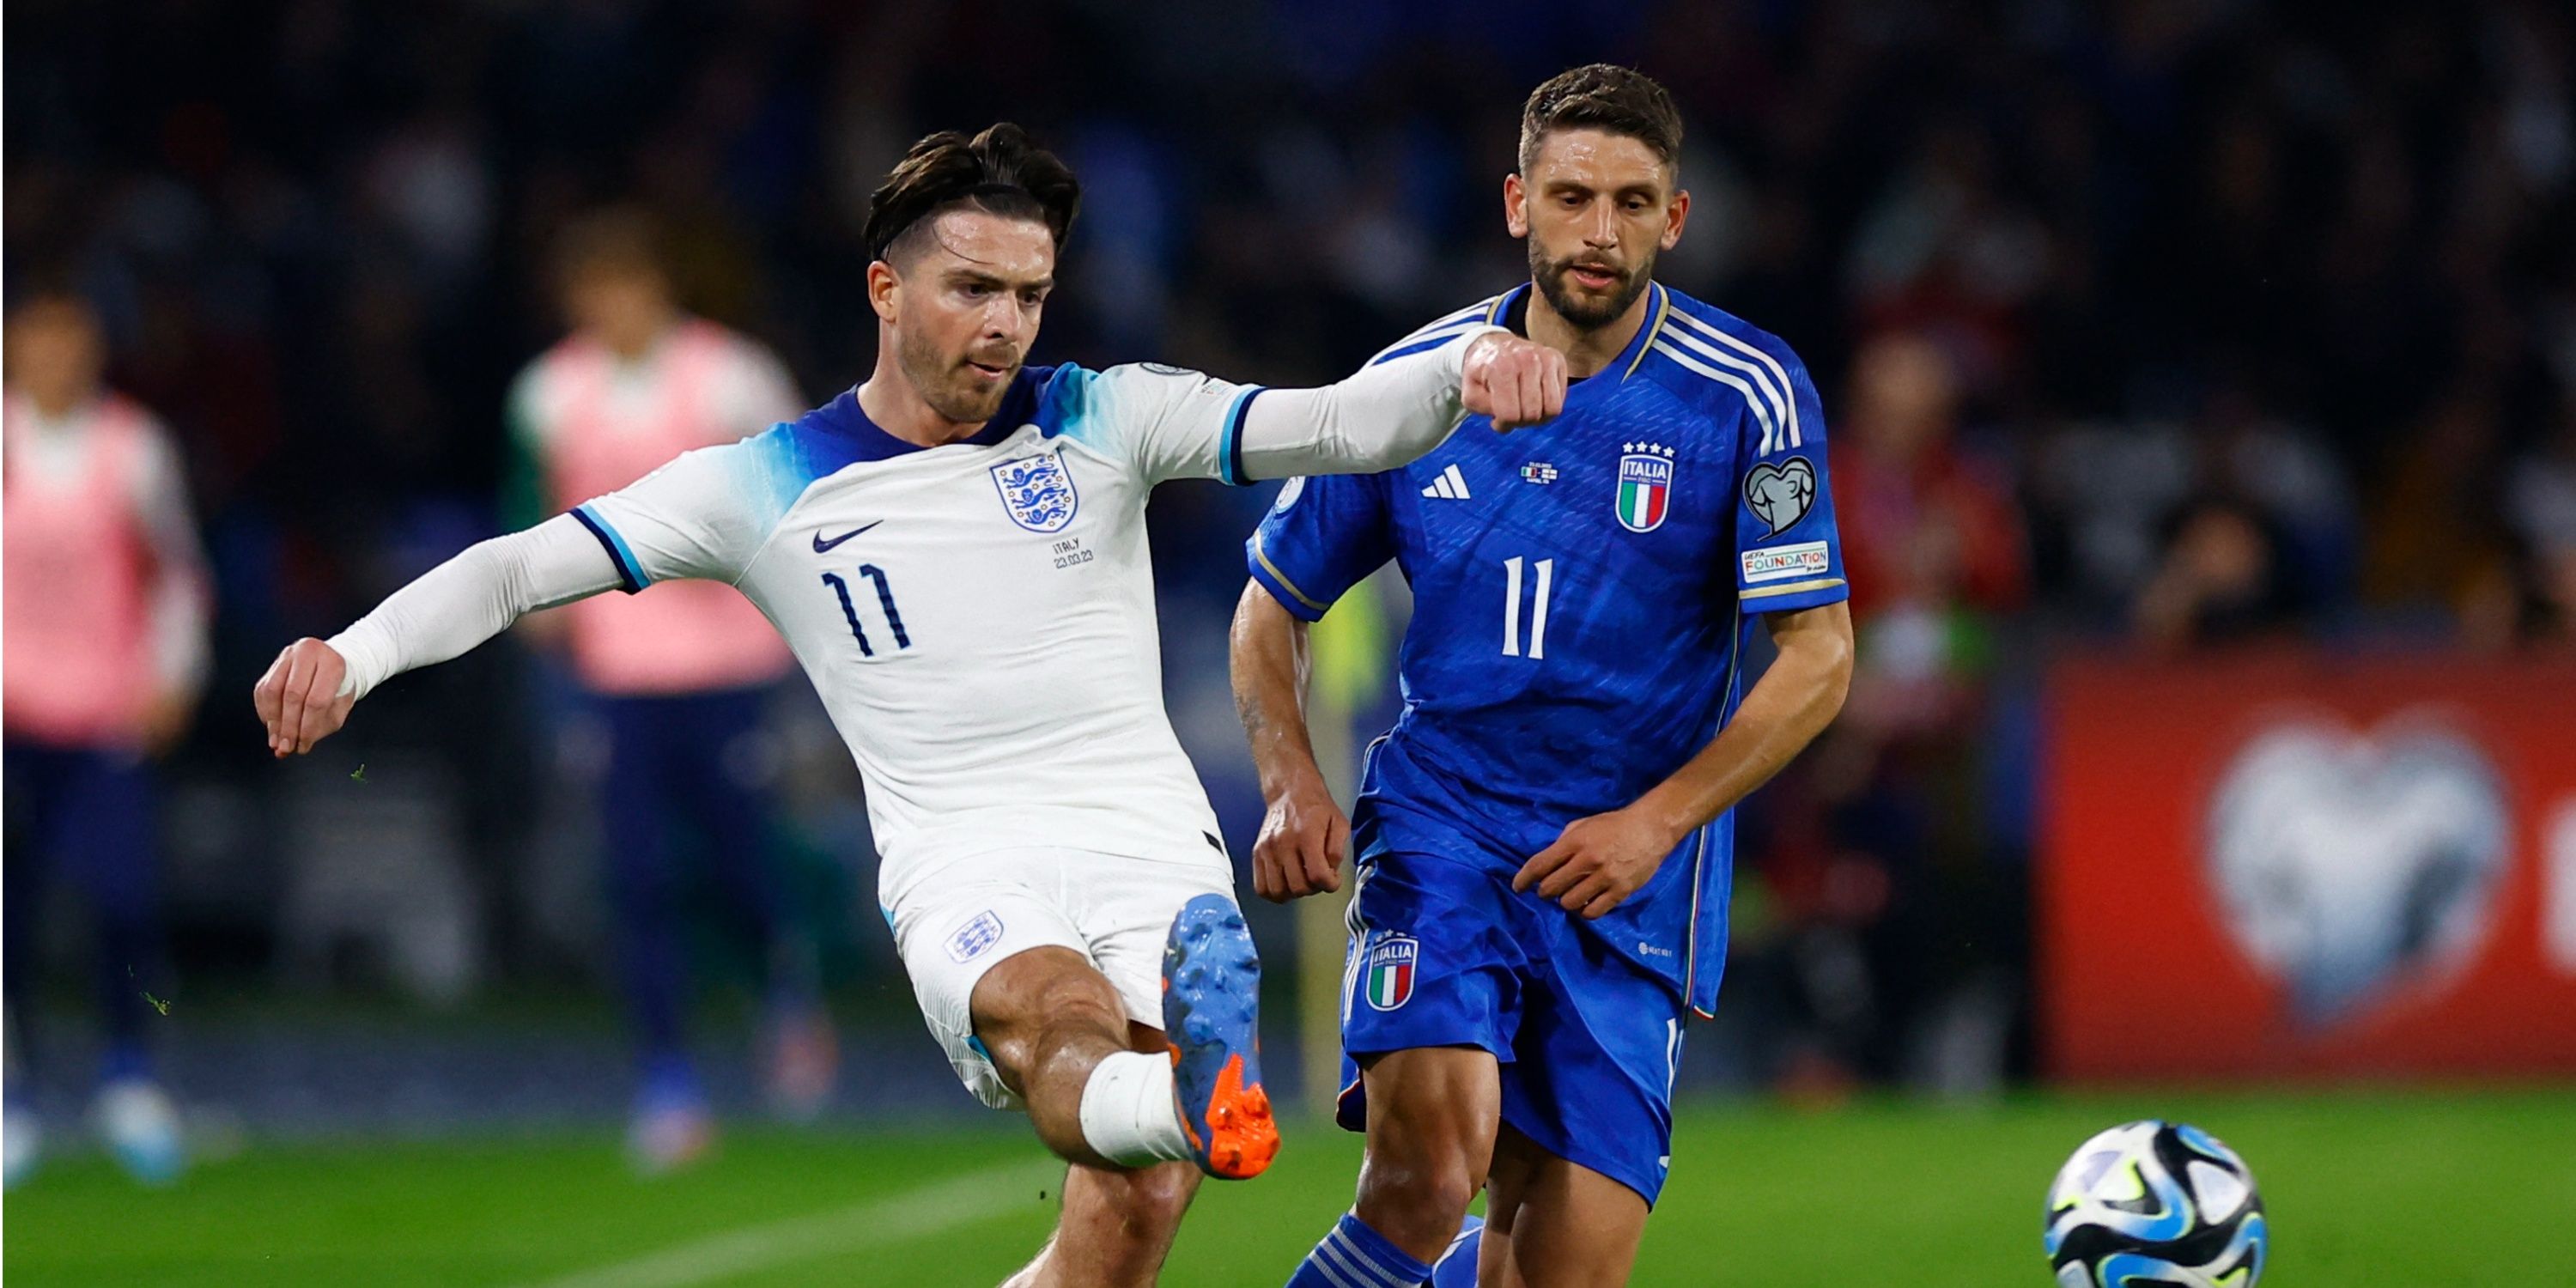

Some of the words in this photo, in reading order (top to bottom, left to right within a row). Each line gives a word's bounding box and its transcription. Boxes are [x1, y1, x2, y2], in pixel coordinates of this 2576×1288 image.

[1624, 460, 1667, 479] ITALIA
[1053, 537, 1079, 555] ITALY
[1054, 550, 1094, 568] 23.03.23
[821, 563, 912, 658] 11
[1502, 556, 1553, 660] 11
[1375, 945, 1412, 963] ITALIA
